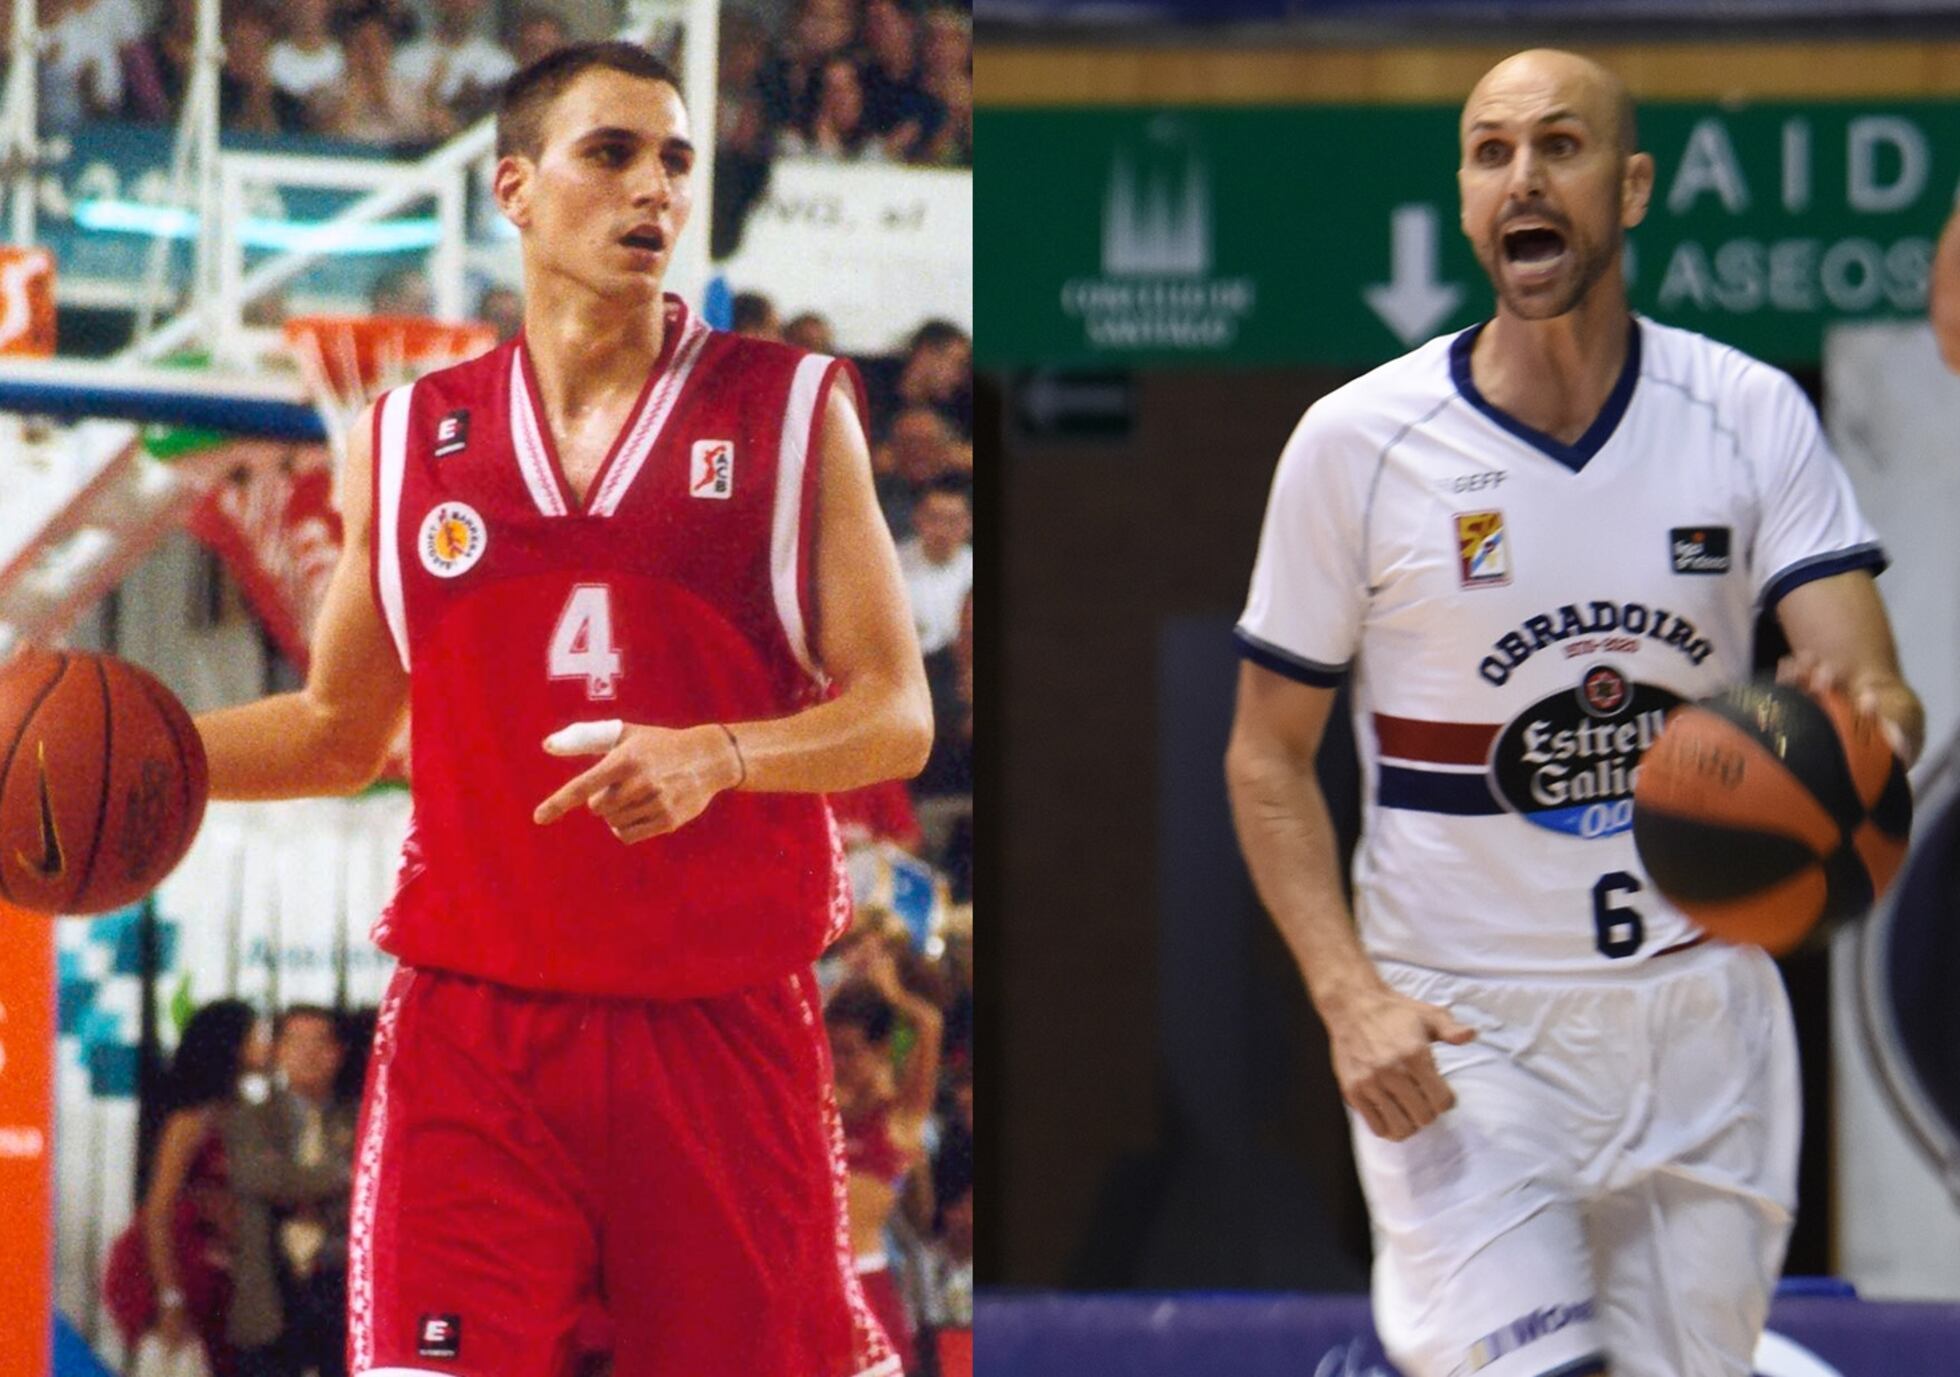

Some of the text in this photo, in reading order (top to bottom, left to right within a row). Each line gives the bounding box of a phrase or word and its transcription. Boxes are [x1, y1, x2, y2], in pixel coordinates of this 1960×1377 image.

[1668, 116, 1931, 214] AID
[1657, 238, 1934, 310] ASEOS
[715, 453, 729, 493] ACB
[548, 583, 624, 699] 4
[1479, 600, 1713, 687] OBRADOIRO
[1521, 709, 1664, 763] Estrell
[1591, 870, 1645, 959] 6
